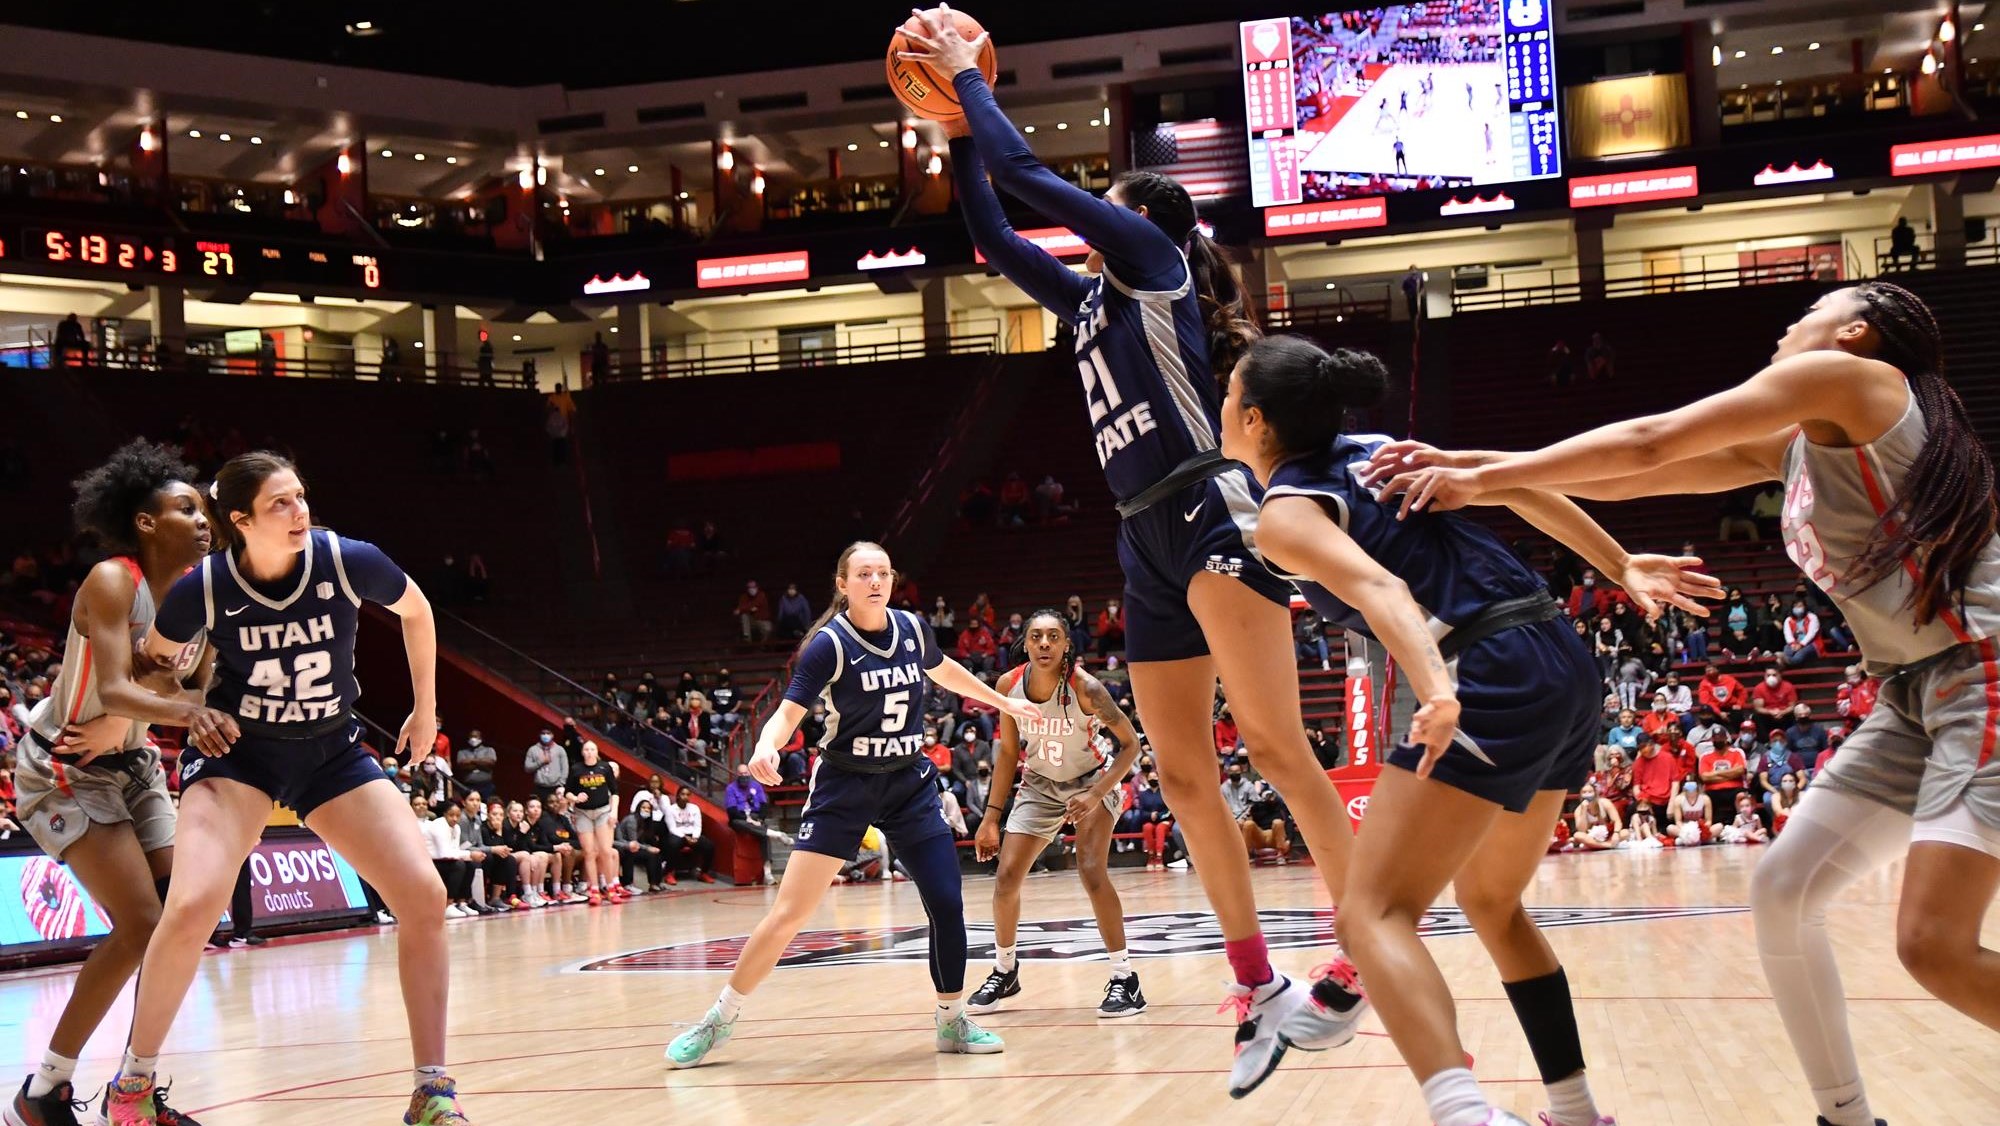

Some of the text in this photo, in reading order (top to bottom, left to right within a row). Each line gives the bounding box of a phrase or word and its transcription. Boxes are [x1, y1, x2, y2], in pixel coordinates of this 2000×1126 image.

[46, 231, 177, 272] 5:13 2 3
[203, 251, 234, 275] 27
[364, 265, 380, 288] 0
[1078, 345, 1123, 427] 21
[238, 613, 335, 652] UTAH
[246, 650, 334, 701] 42
[860, 661, 921, 692] UTAH
[238, 695, 341, 723] STATE
[880, 691, 910, 733] 5
[1351, 677, 1369, 766] LOBOS
[852, 733, 924, 758] STATE
[1037, 738, 1064, 767] 12
[272, 848, 336, 884] BOYS
[264, 888, 314, 912] donuts
